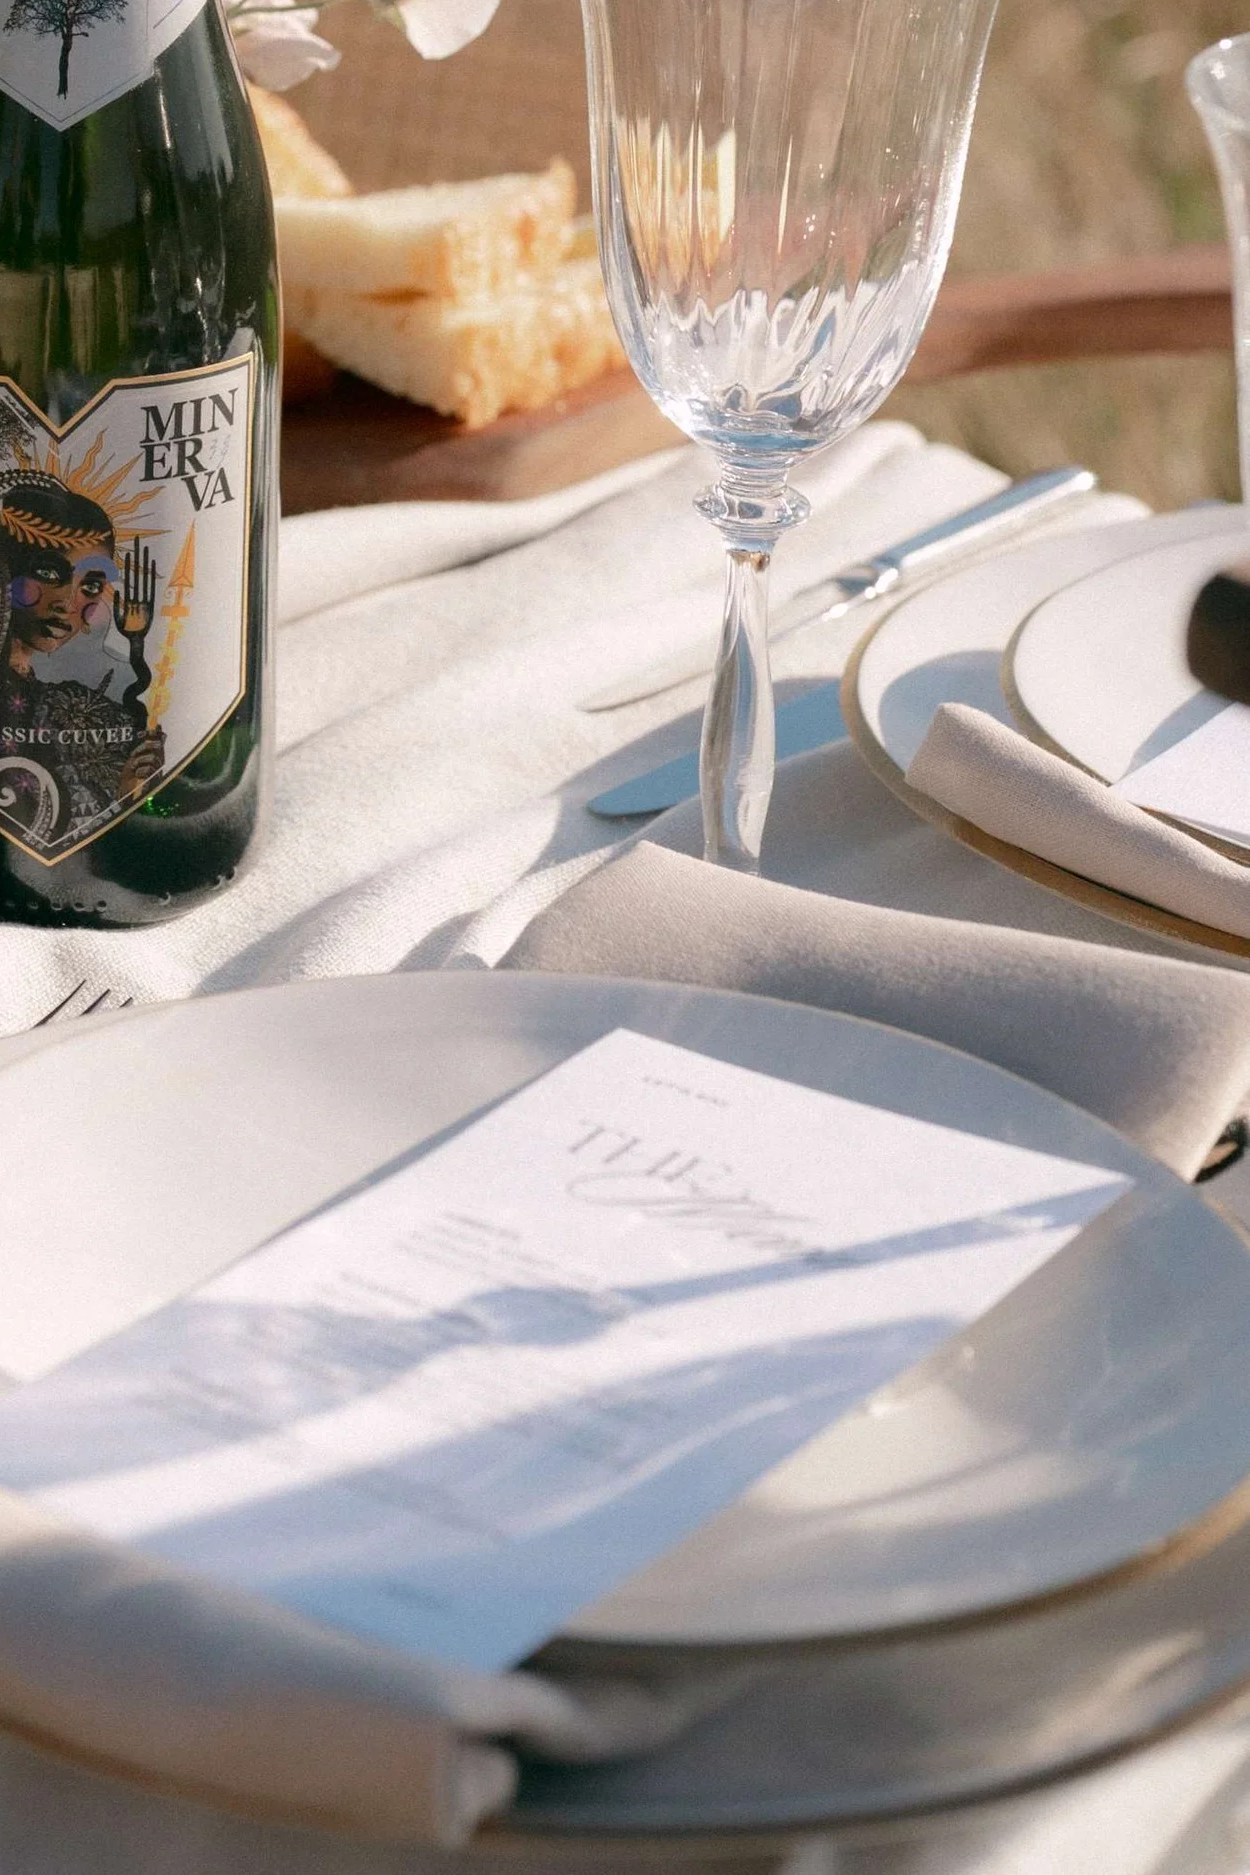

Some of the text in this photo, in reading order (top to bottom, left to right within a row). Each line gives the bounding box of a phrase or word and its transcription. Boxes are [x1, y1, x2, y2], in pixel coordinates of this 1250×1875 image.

[139, 388, 239, 444] MIN
[139, 437, 209, 482] ER
[180, 467, 235, 512] VA
